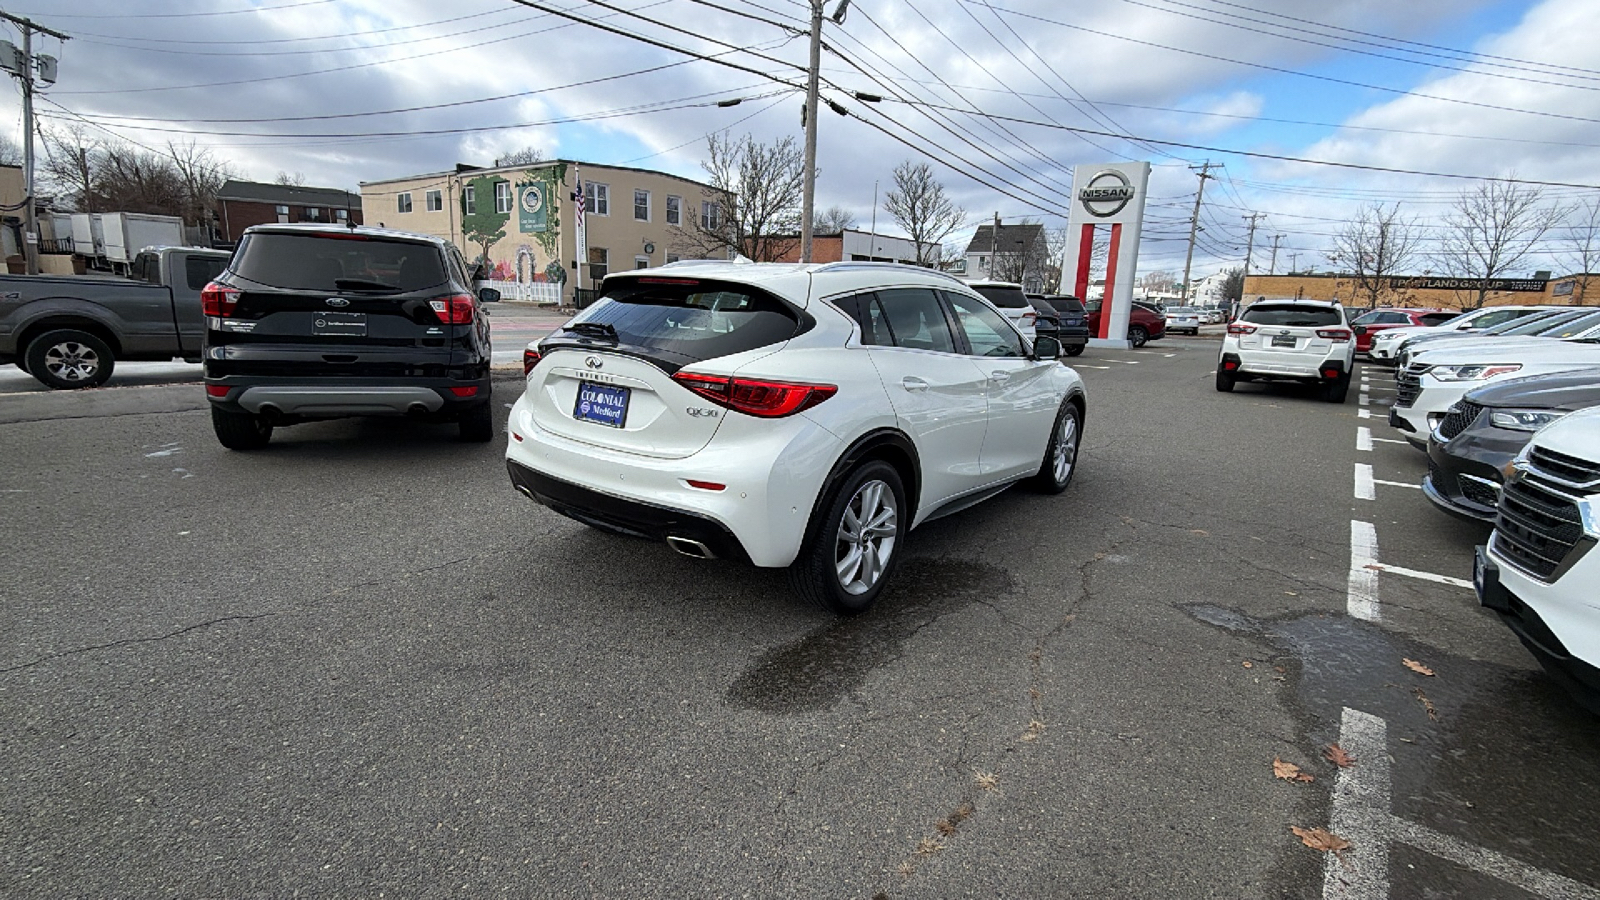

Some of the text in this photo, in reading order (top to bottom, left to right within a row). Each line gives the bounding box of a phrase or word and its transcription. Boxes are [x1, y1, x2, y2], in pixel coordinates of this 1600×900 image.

[1082, 188, 1129, 198] NISSAN
[581, 390, 624, 407] COLONIAL
[686, 406, 718, 418] QX30
